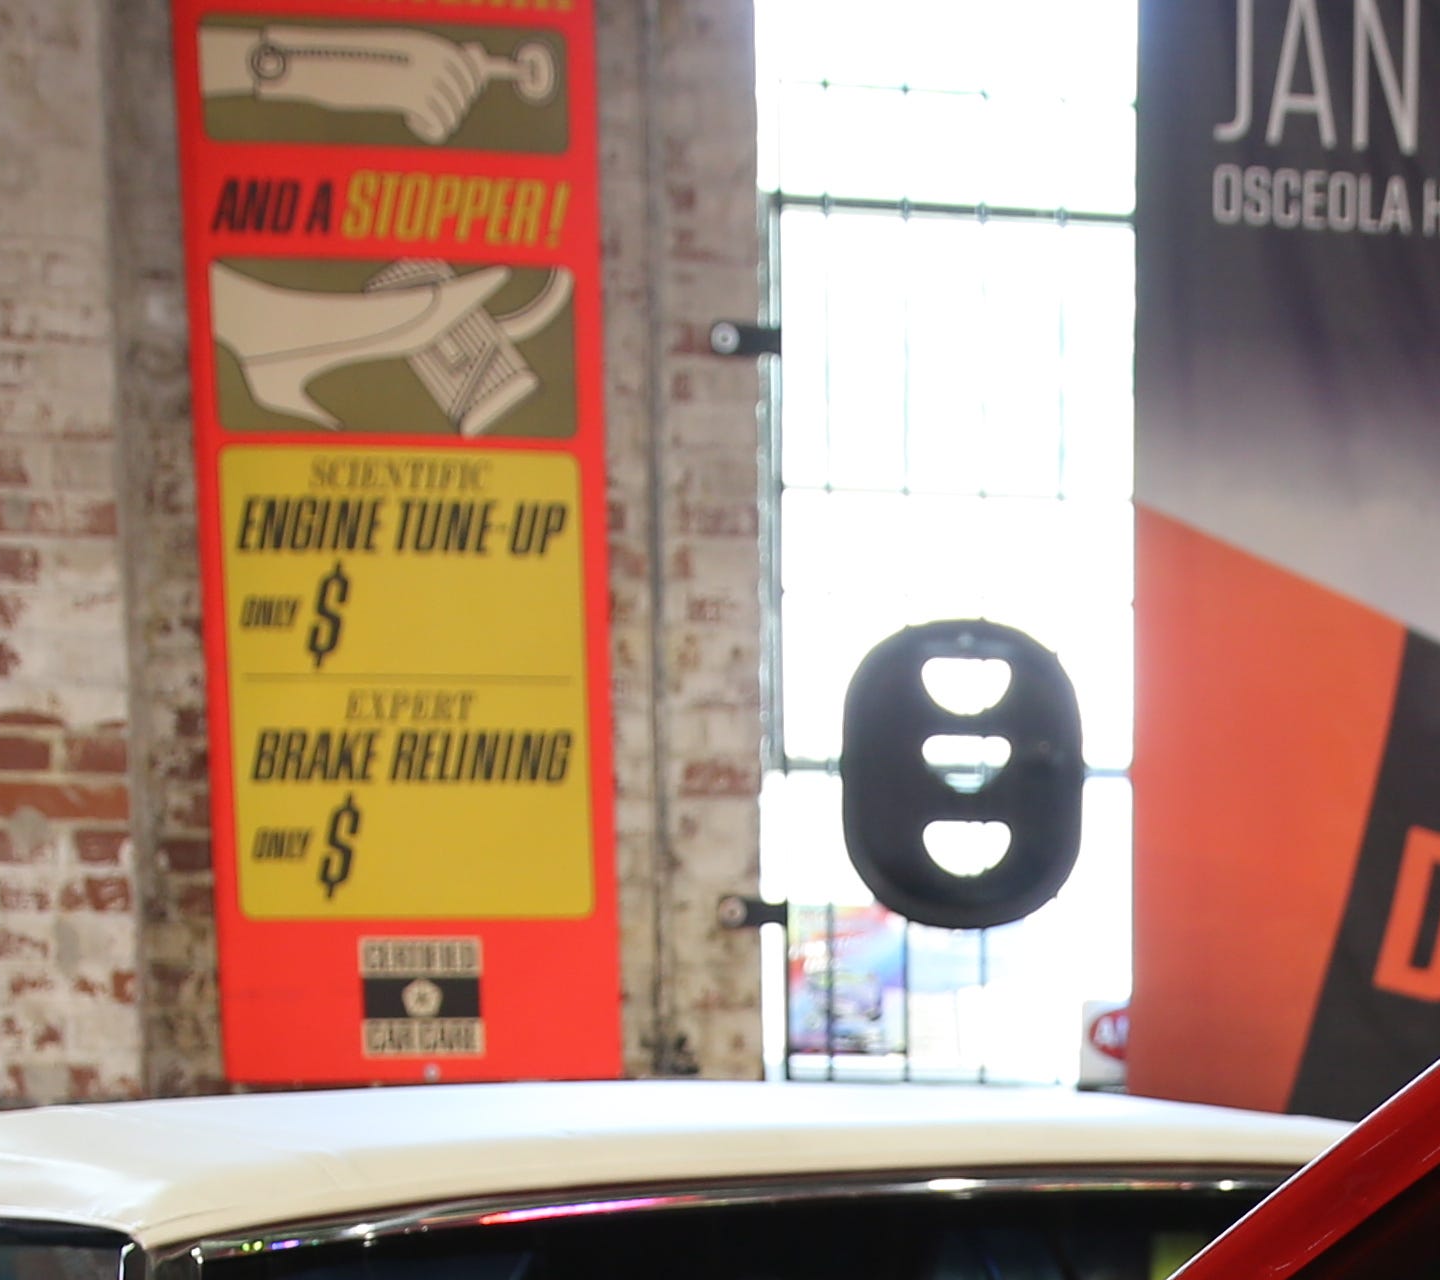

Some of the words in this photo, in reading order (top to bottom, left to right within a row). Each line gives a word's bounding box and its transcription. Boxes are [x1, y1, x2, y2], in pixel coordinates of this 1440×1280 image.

[1214, 0, 1418, 156] JAN
[212, 178, 301, 236] AND
[306, 180, 334, 236] A
[1213, 164, 1412, 234] OSCEOLA
[310, 455, 492, 491] SCIENTIFIC
[237, 493, 384, 552] ENGINE
[394, 498, 568, 557] TUNE-UP
[240, 595, 300, 628] ONLY
[345, 689, 476, 722] EXPERT
[252, 728, 380, 782] BRAKE
[390, 730, 572, 785] RELINING
[252, 826, 311, 862] ONLY
